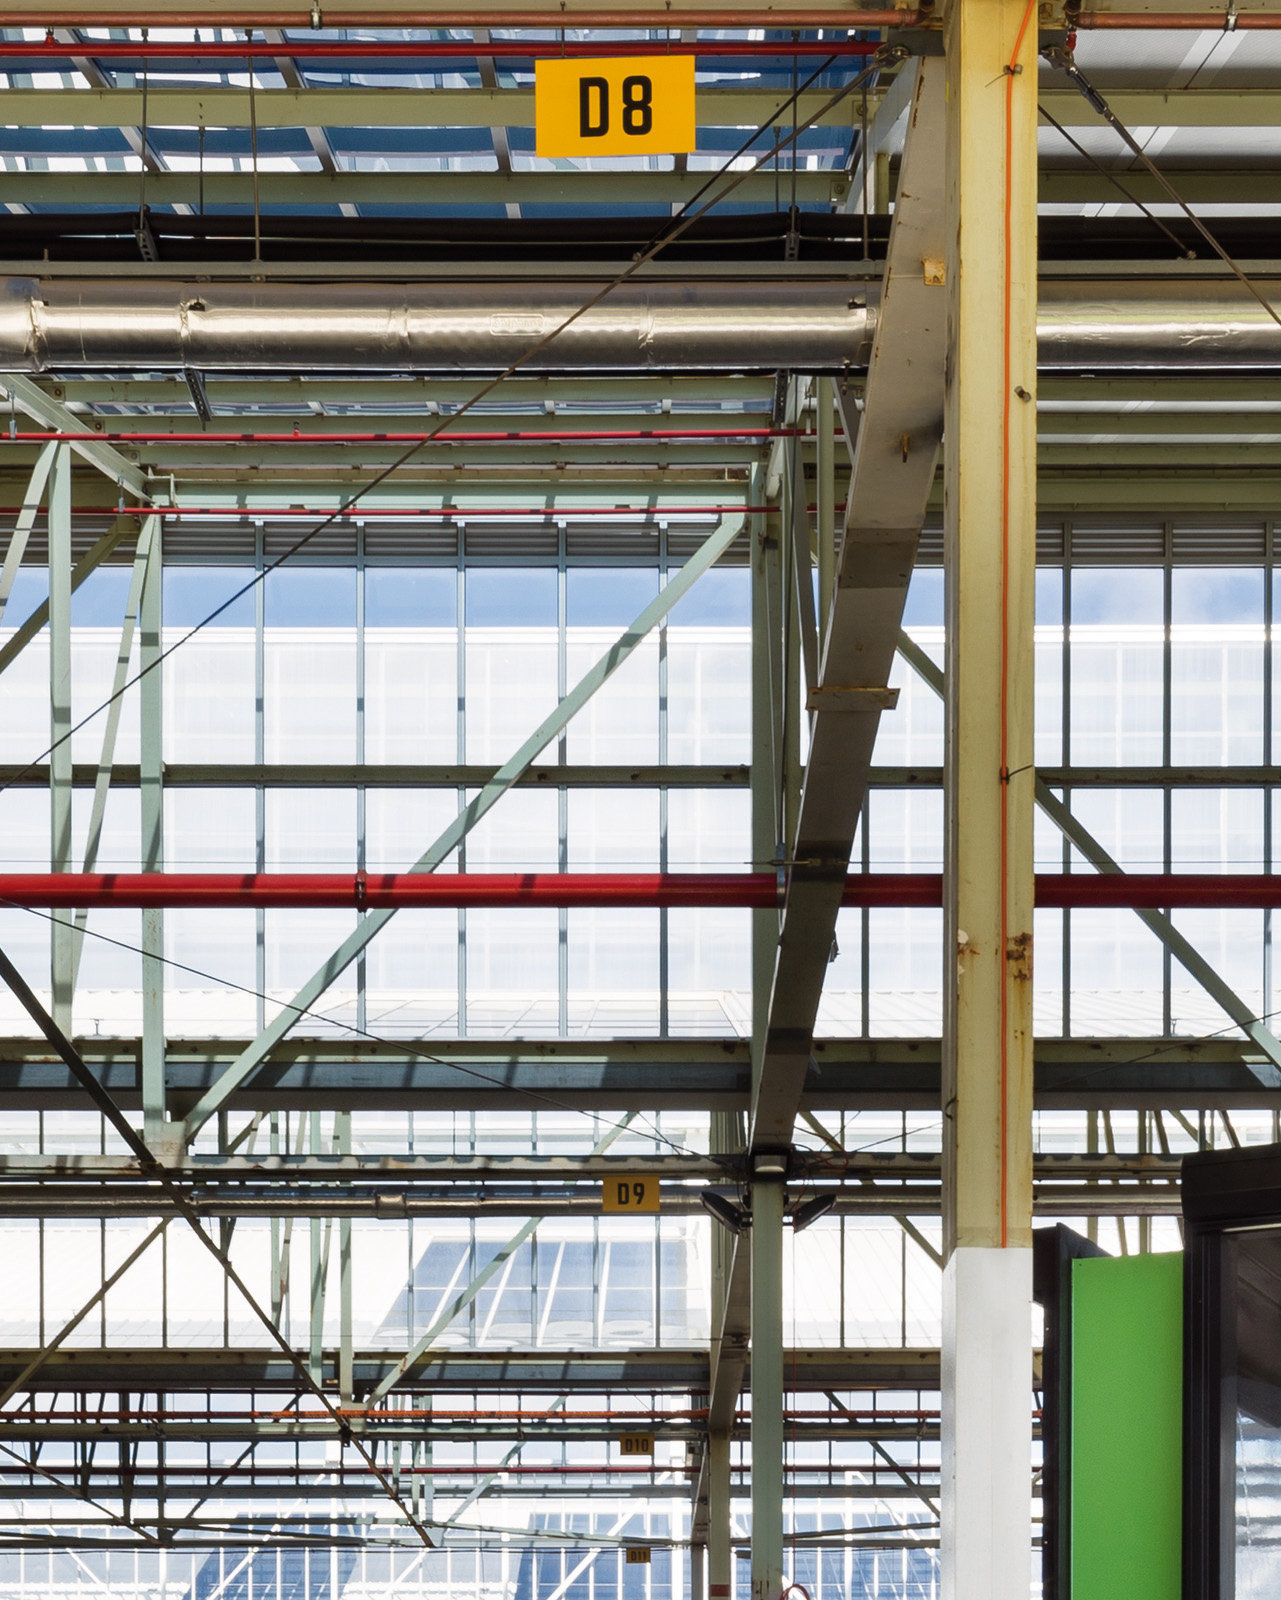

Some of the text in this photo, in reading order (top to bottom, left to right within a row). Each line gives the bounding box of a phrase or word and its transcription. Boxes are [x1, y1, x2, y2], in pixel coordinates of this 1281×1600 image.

[579, 75, 653, 138] D8
[617, 1182, 645, 1205] D9
[625, 1438, 649, 1453] D10
